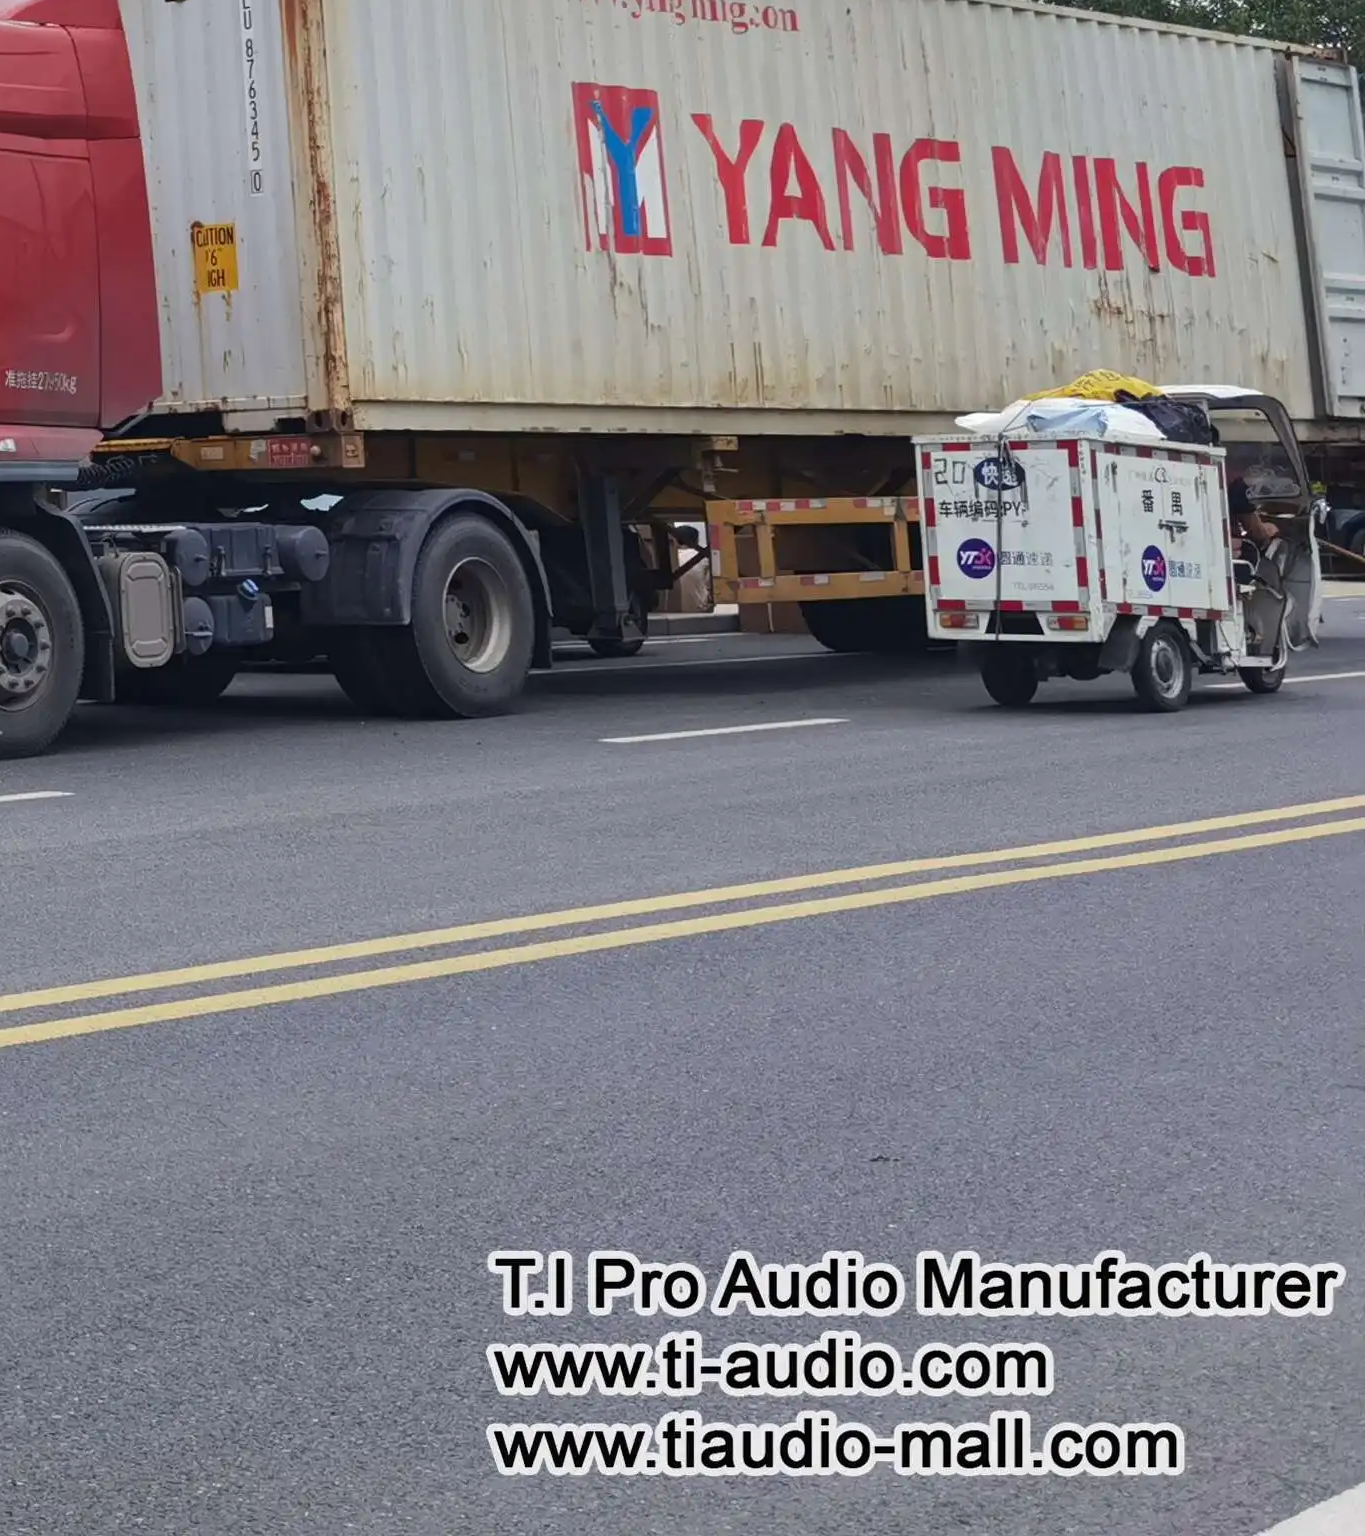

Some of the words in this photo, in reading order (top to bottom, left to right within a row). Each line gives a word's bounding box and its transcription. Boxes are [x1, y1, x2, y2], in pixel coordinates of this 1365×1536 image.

[244, 38, 261, 162] 876345
[690, 113, 972, 260] YANG
[991, 145, 1217, 278] MING
